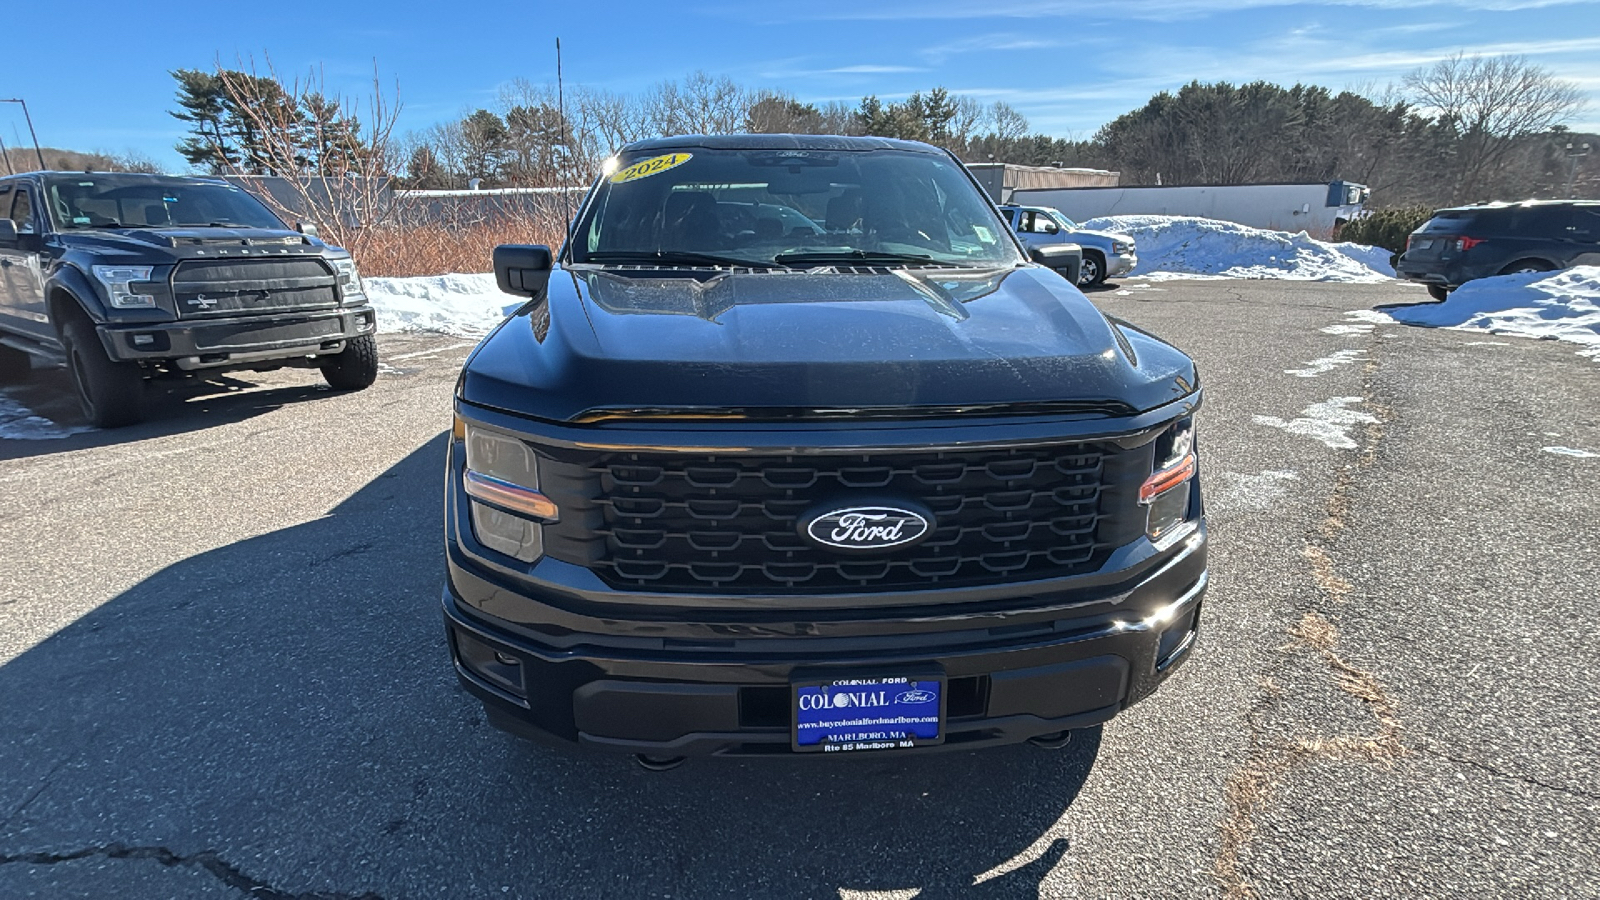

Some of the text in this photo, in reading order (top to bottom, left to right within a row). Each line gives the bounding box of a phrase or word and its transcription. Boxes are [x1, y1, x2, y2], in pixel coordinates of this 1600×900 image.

[624, 155, 678, 180] 2024
[831, 513, 906, 541] Ford
[799, 691, 890, 711] COLONIAL
[797, 716, 939, 730] www.buycolonialfordmarlboro.com
[889, 730, 906, 740] MA
[824, 740, 914, 753] Rte 85 Marlboro MA
